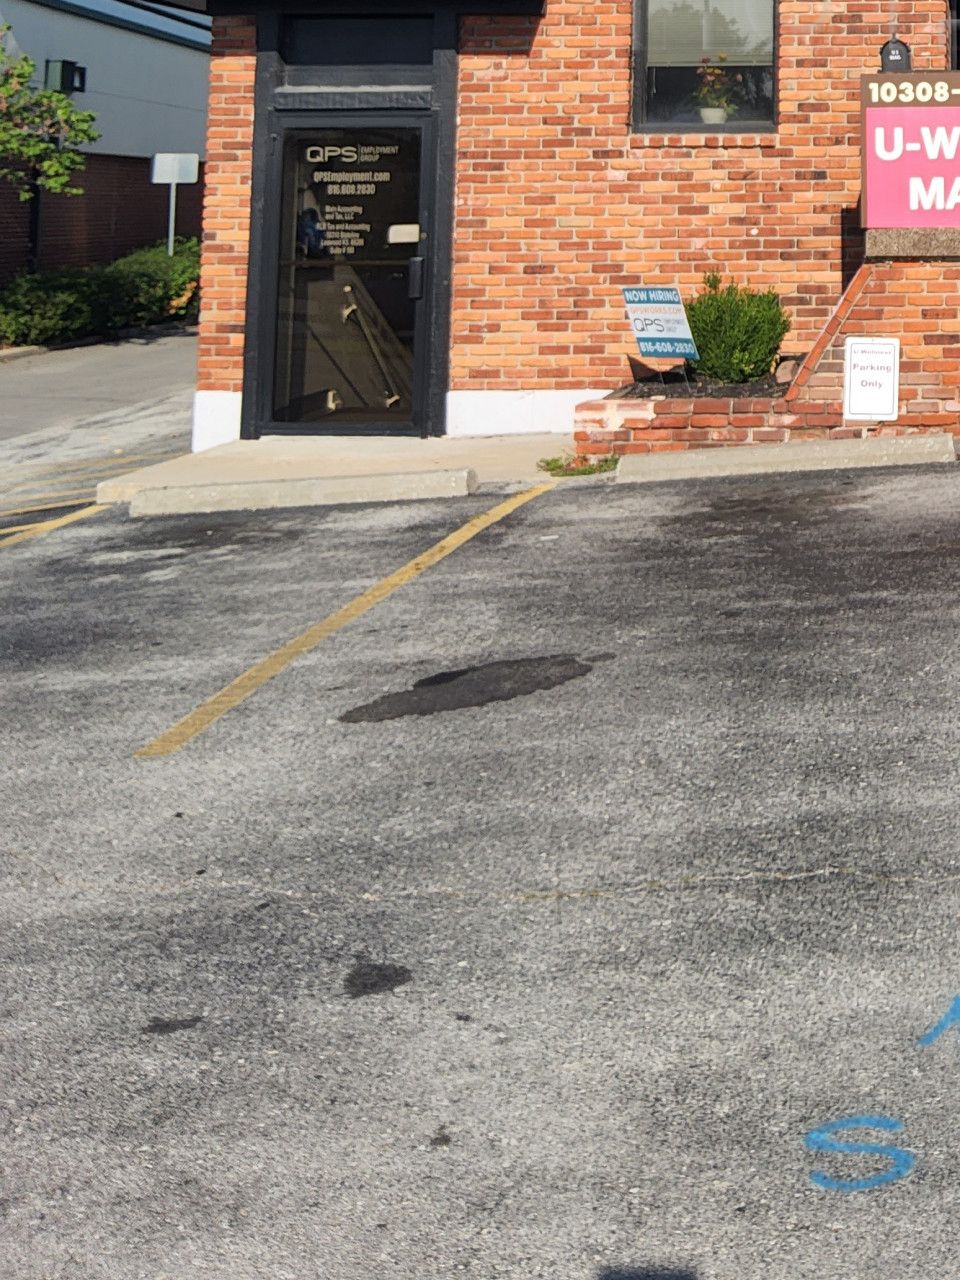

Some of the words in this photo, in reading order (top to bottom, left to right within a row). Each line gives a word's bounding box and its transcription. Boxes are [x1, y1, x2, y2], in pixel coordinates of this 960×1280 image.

[306, 146, 357, 163] QPS
[360, 146, 399, 154] EMPLOYMENT
[360, 154, 380, 162] GROUP
[313, 171, 391, 183] QPSEmployment.com
[624, 290, 647, 302] NOW
[649, 290, 680, 302] HIRING
[633, 317, 665, 333] QPS
[852, 363, 892, 373] Parking
[860, 380, 882, 389] Only
[803, 1114, 916, 1193] S
